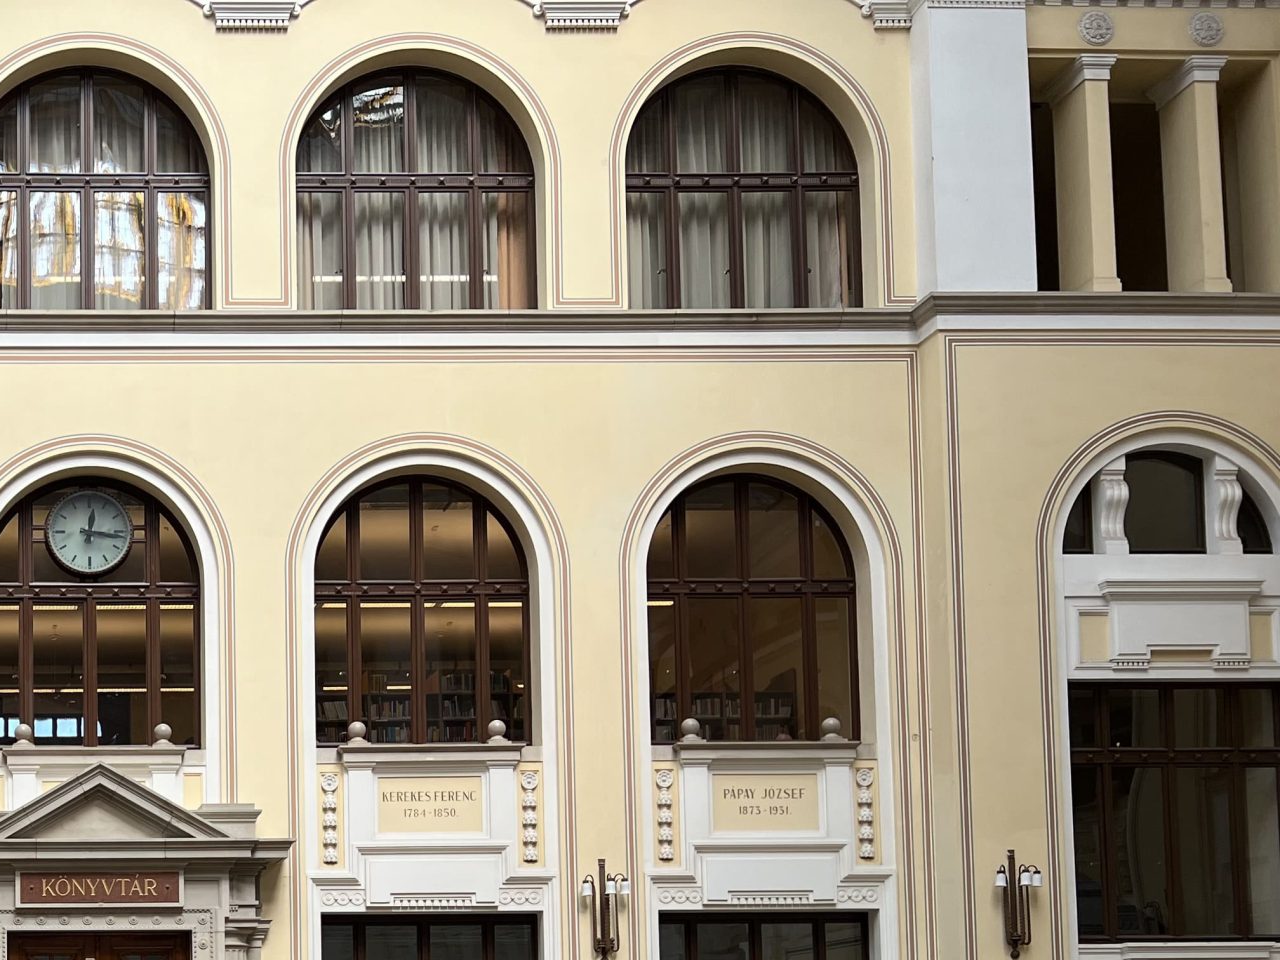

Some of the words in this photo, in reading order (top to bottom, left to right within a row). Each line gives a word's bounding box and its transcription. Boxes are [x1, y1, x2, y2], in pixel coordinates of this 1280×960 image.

[382, 790, 432, 802] KEREKES
[434, 790, 477, 801] FERENC
[723, 786, 756, 800] PÁPAY
[761, 786, 806, 800] JÓZSEF
[41, 873, 158, 897] KÖNYVTÁR
